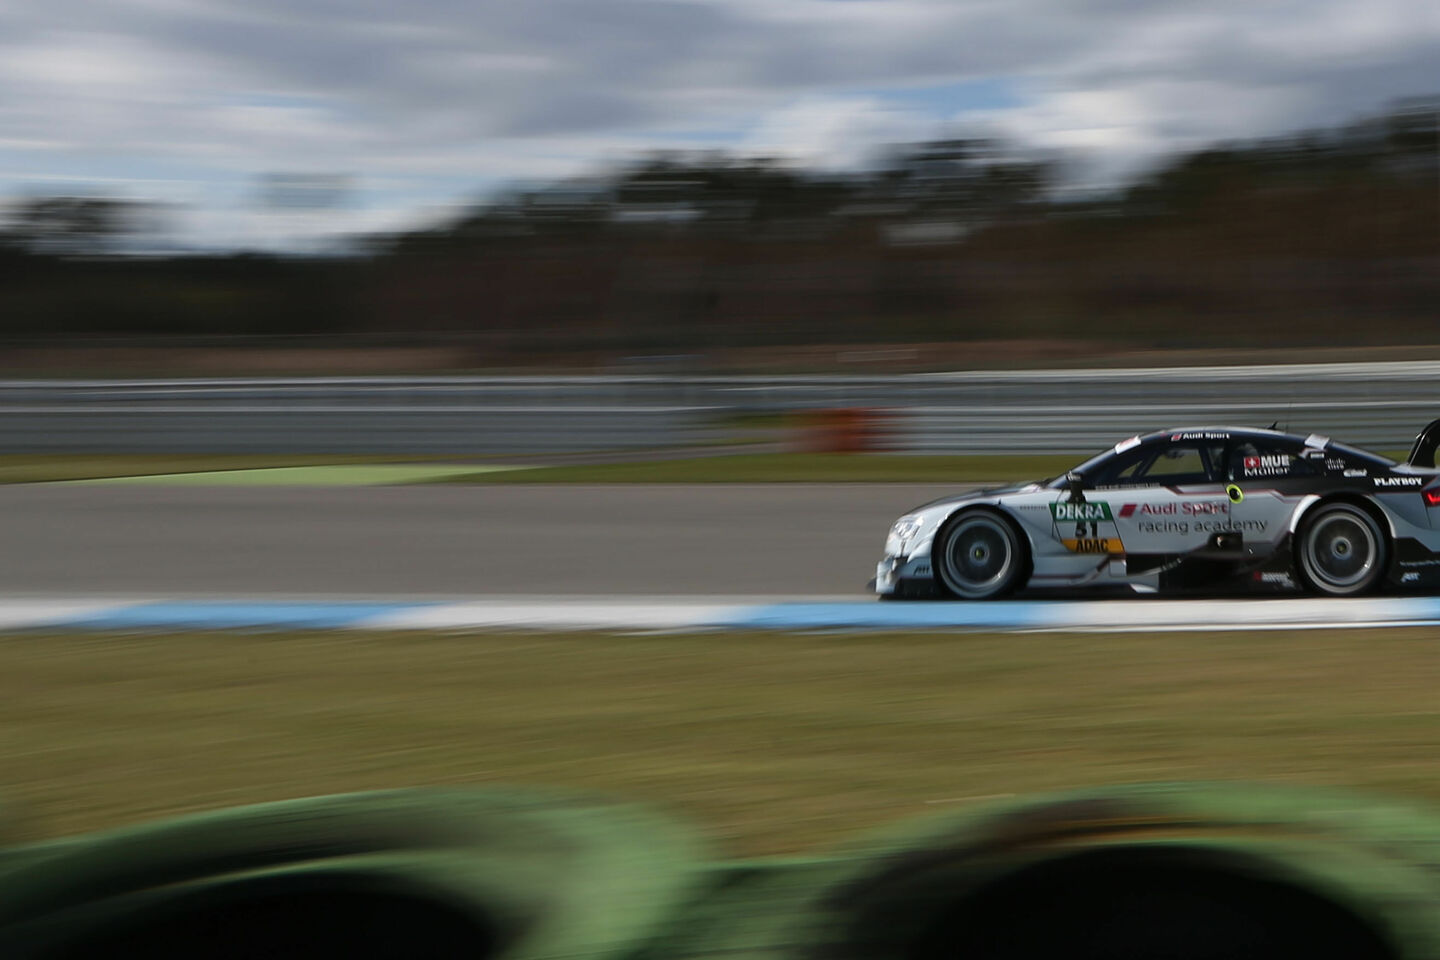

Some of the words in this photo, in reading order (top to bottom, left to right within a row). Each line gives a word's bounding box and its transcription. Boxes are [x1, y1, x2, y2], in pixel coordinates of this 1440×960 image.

[1182, 432, 1203, 440] Audi
[1205, 432, 1230, 440] Sport
[1261, 455, 1290, 468] MUE
[1373, 477, 1422, 486] PLAYBOY
[1056, 503, 1105, 520] DEKRA
[1141, 502, 1177, 515] Audi
[1181, 502, 1229, 517] Sport
[1138, 520, 1188, 536] racing
[1194, 518, 1268, 534] academy
[1076, 538, 1109, 553] ADAC
